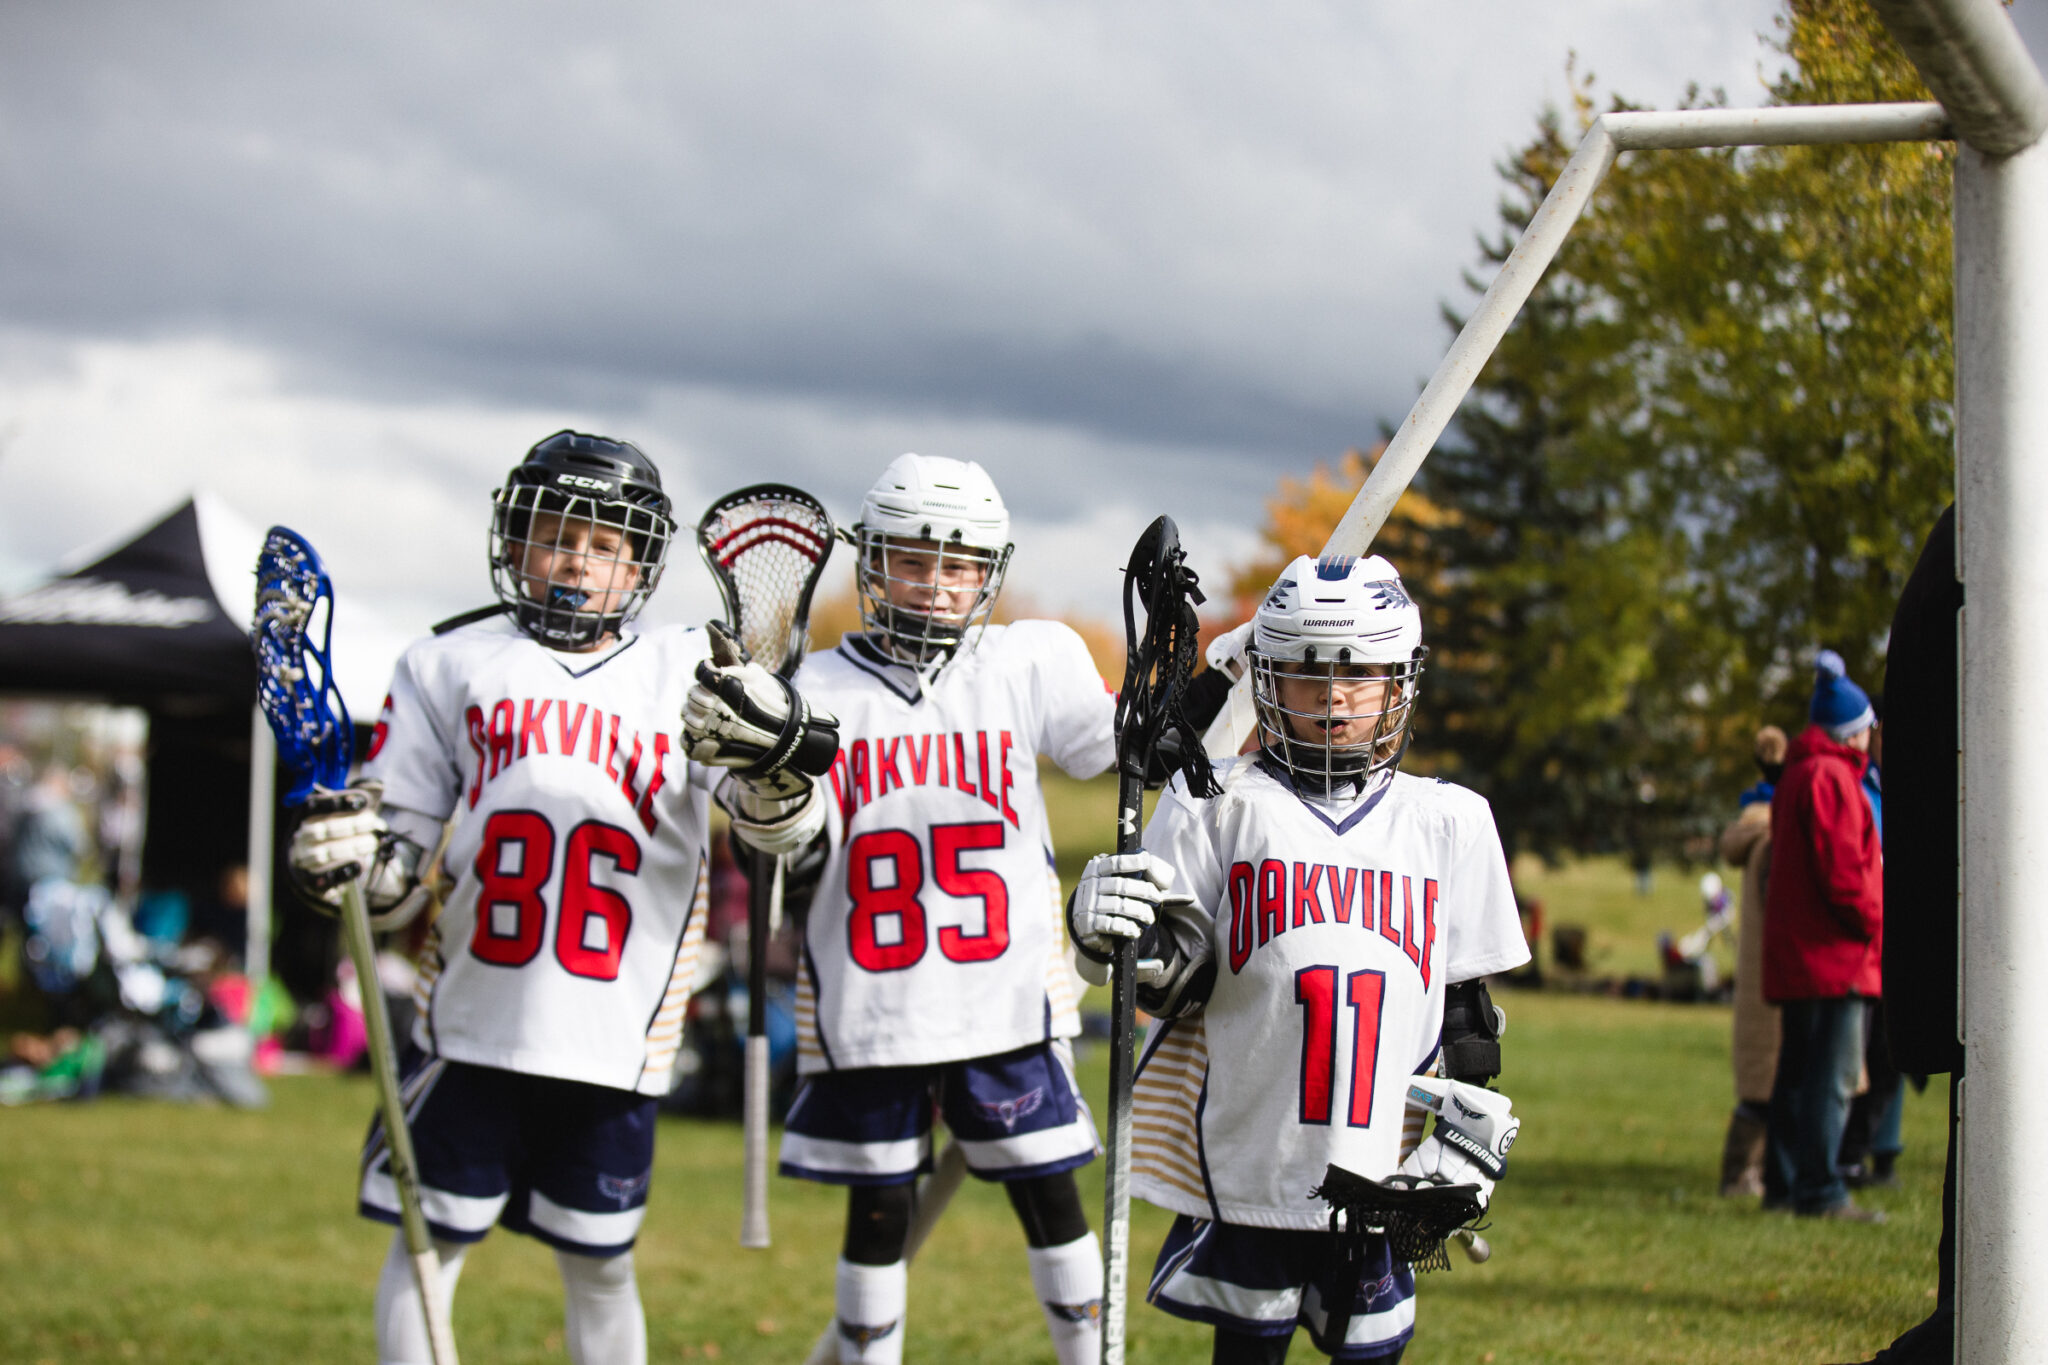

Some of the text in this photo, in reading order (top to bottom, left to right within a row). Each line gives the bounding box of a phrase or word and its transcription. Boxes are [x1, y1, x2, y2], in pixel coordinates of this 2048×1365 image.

[557, 473, 613, 492] CCM
[1303, 619, 1355, 627] WARRIOR
[465, 697, 671, 838] OAKVILLE
[829, 730, 1021, 848] OAKVILLE
[469, 808, 642, 982] 86
[846, 820, 1010, 974] 85
[1228, 857, 1439, 995] OAKVILLE
[1294, 964, 1387, 1130] 11
[1443, 1129, 1502, 1172] WARRIOR
[1105, 1218, 1129, 1365] ARMOUR
